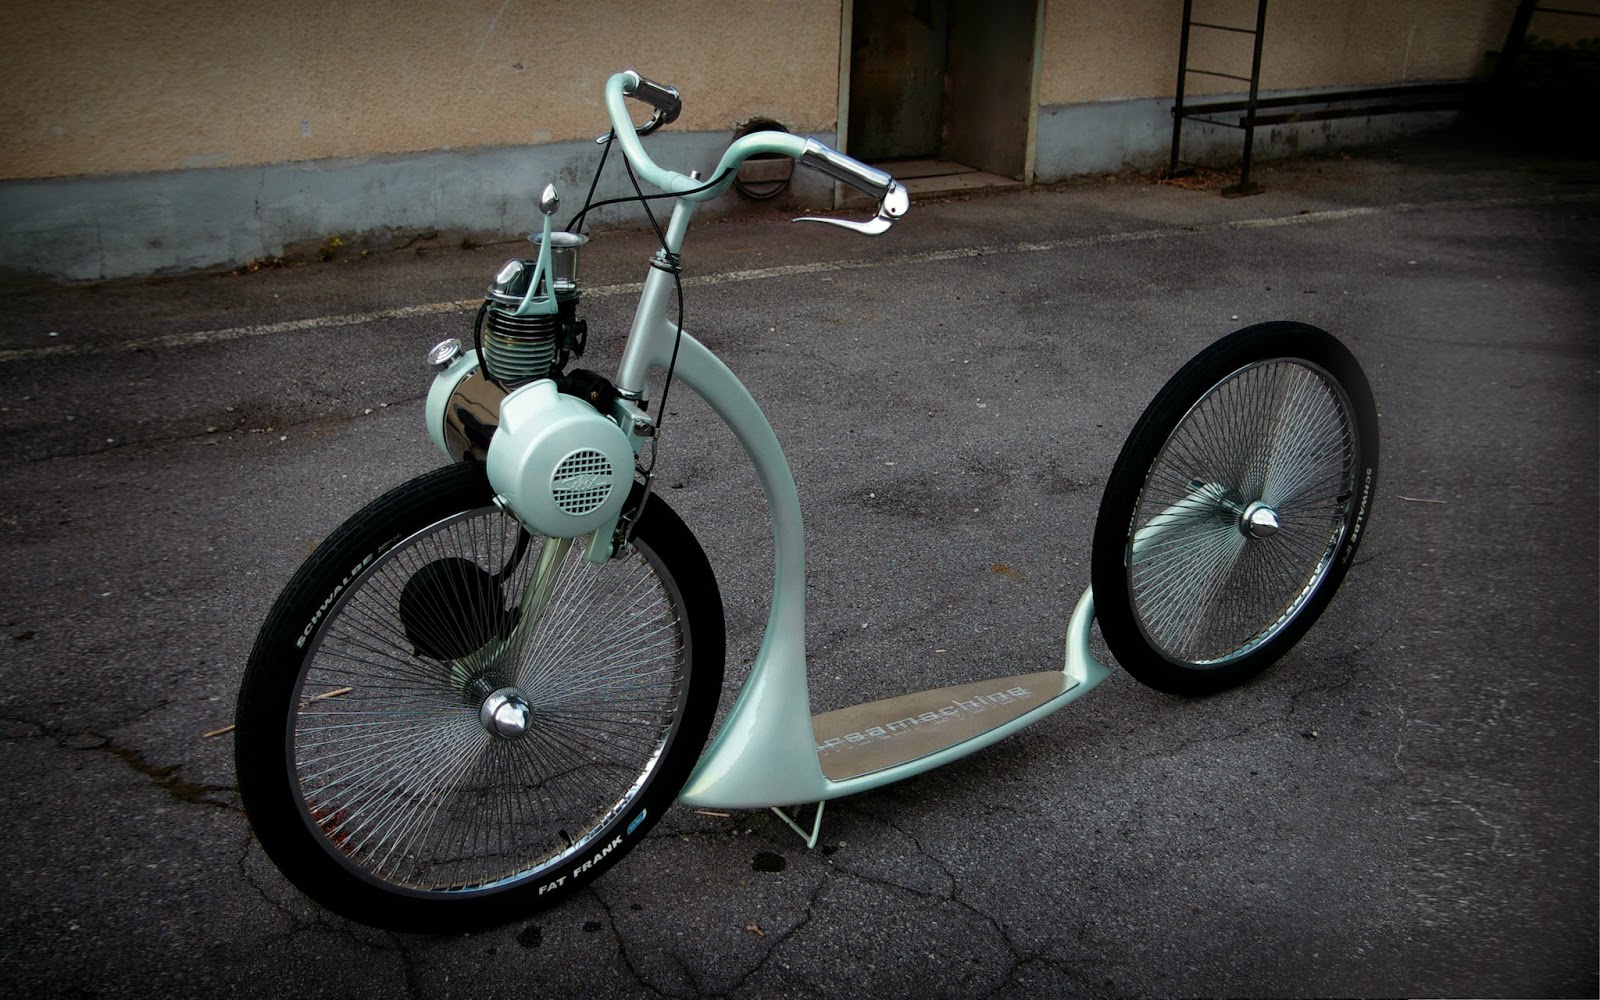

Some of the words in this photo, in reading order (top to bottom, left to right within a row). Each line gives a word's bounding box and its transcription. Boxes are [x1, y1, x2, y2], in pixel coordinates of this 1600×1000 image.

[1350, 467, 1373, 543] SCHWALBE
[296, 553, 373, 649] SCHWALBE
[538, 876, 567, 896] FAT
[573, 834, 623, 878] FRANK
